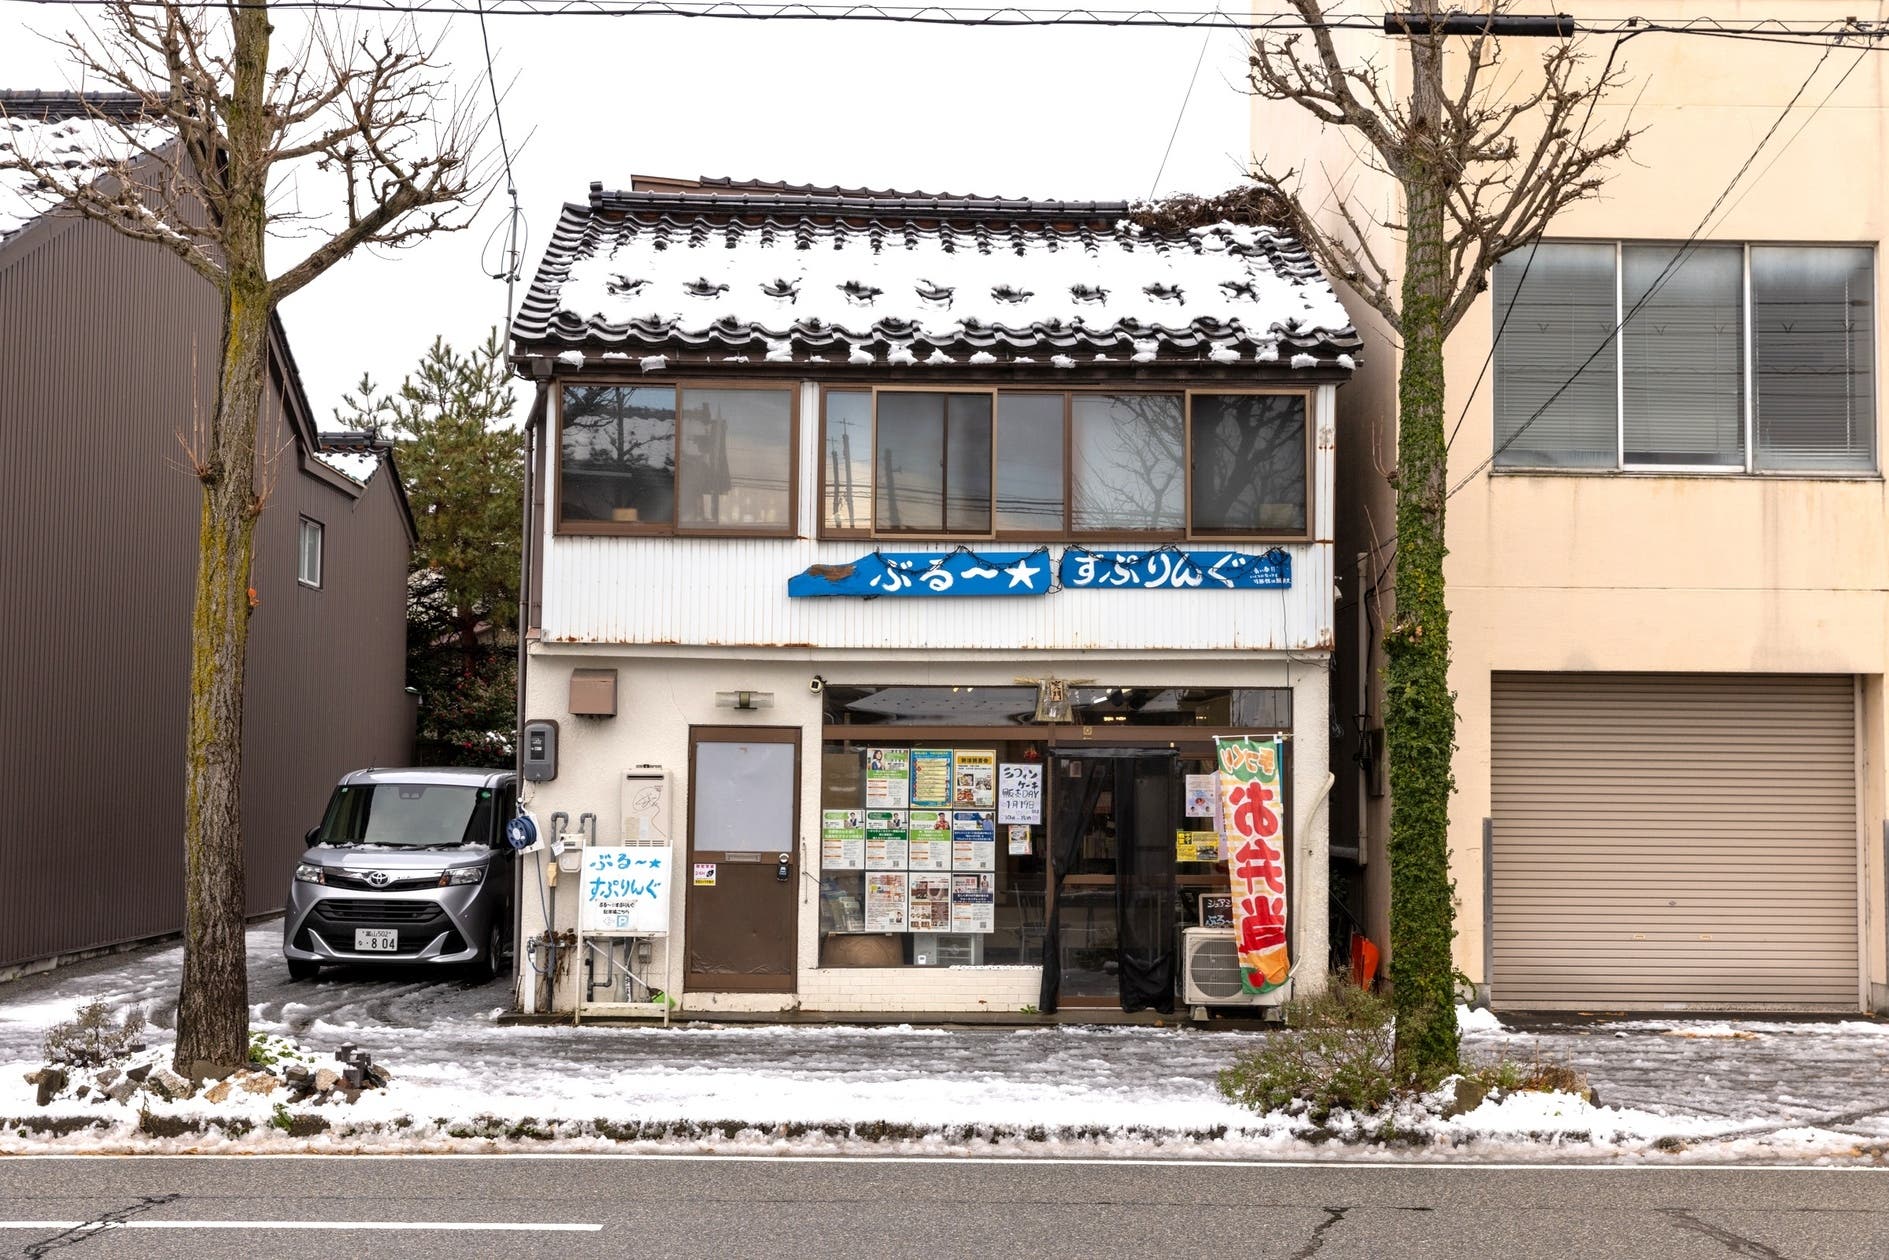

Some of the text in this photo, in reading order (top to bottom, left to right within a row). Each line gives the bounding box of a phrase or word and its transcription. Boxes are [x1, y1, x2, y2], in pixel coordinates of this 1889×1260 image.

[1072, 553, 1247, 588] すぷりんぐ
[1018, 780, 1039, 790] ケーキ
[589, 876, 662, 902] すぷりんぐ
